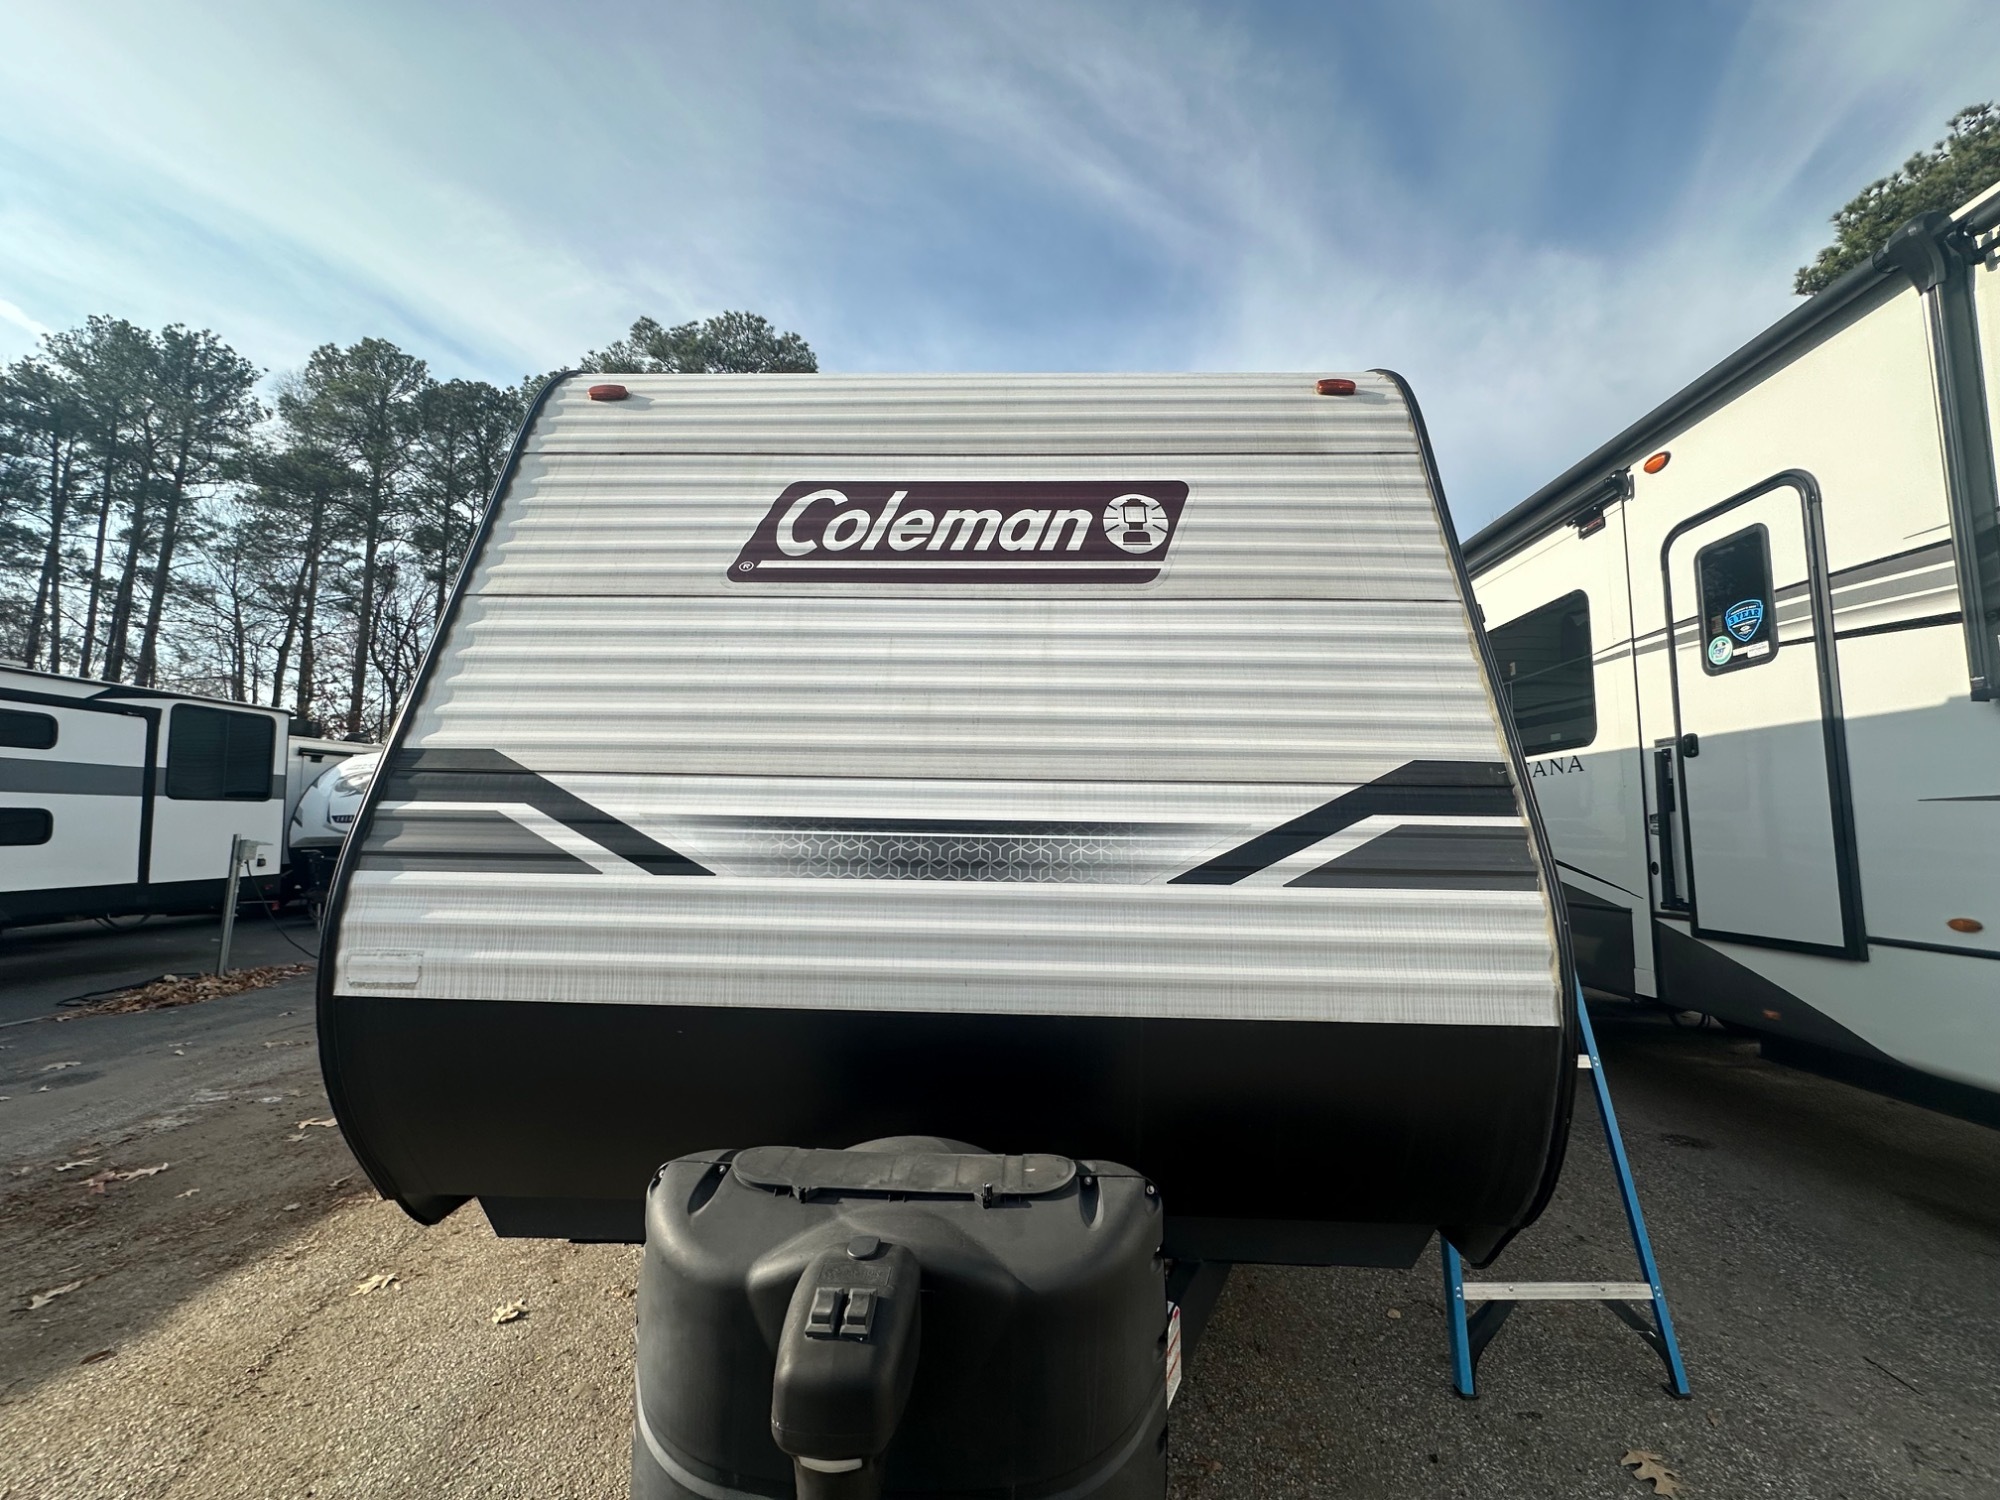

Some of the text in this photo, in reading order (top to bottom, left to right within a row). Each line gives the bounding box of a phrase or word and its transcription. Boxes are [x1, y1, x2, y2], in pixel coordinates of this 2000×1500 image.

[776, 489, 1093, 557] Coleman
[1736, 609, 1759, 620] YEAR
[1527, 755, 1585, 778] ANA
